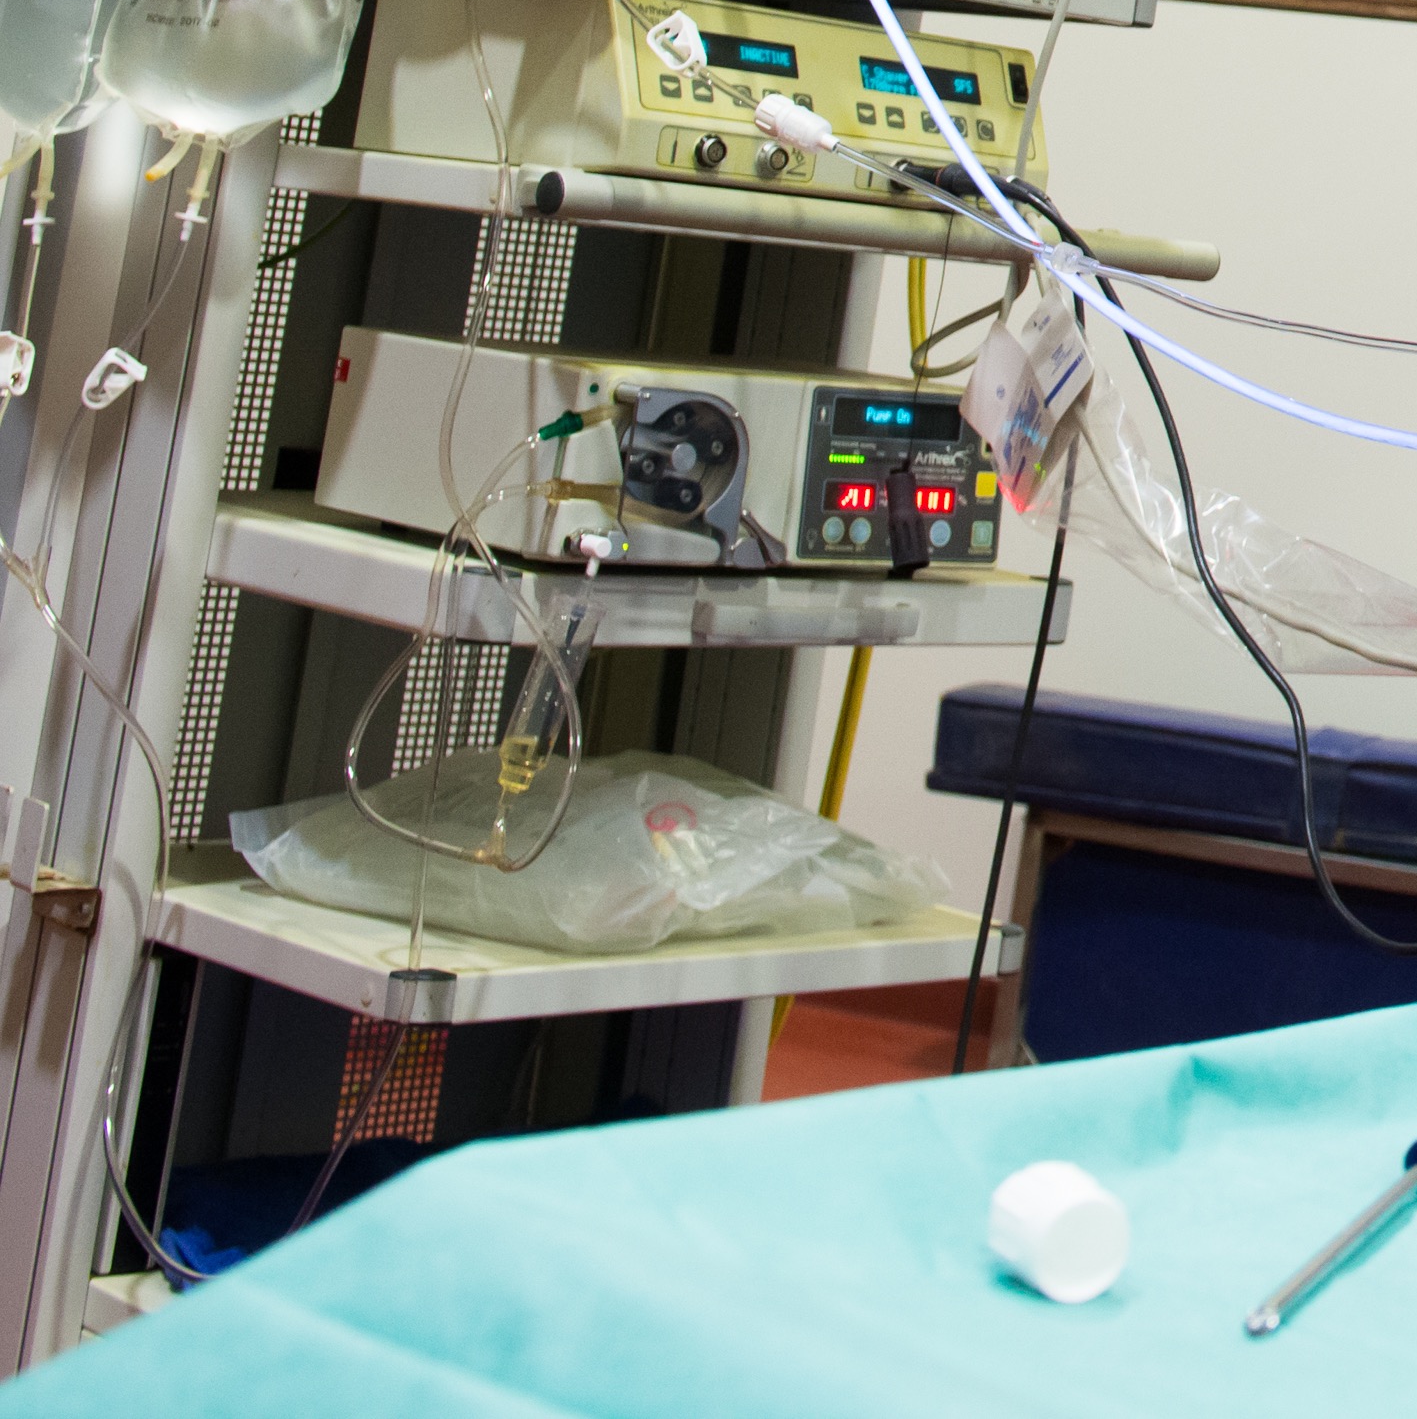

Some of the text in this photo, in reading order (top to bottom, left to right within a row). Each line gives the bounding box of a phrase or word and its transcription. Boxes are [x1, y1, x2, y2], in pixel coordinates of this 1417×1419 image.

[739, 44, 792, 68] INACTIVE
[865, 406, 893, 424] Pump
[914, 450, 957, 467] Arthrex
